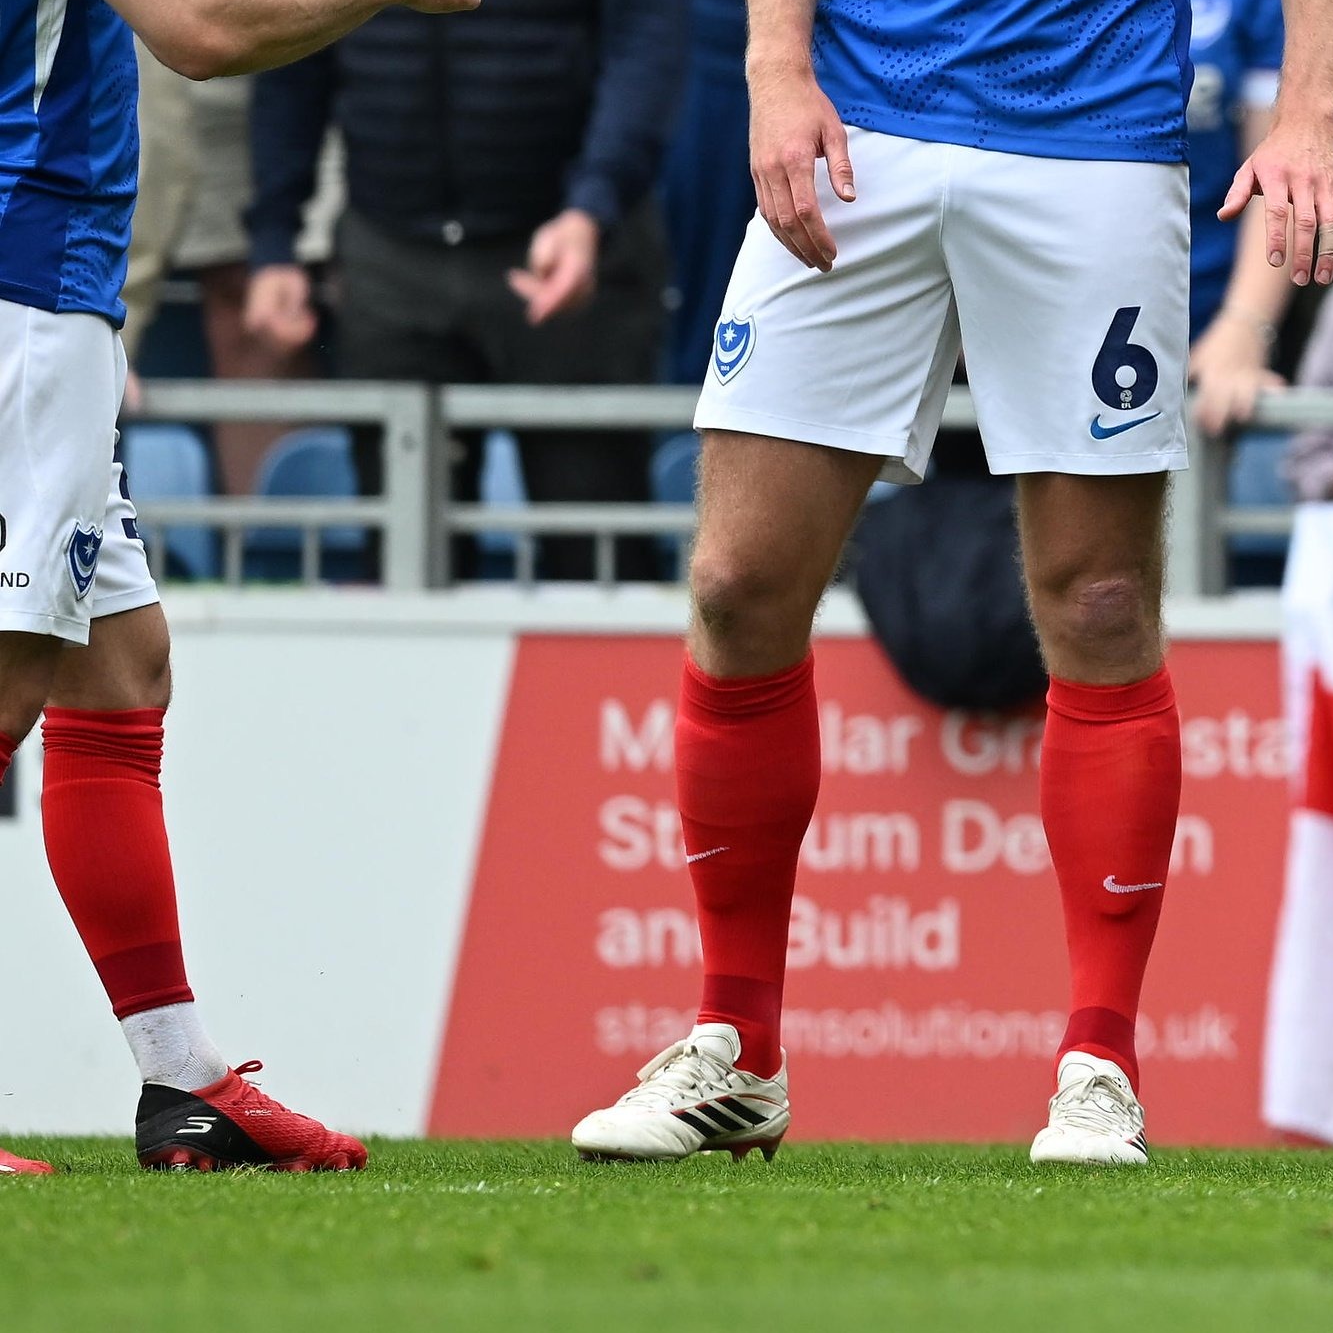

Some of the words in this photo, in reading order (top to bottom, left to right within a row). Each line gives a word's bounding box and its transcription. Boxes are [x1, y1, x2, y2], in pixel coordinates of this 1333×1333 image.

[1091, 305, 1159, 411] 6
[602, 698, 925, 775] Mlar
[598, 794, 922, 874] Stum
[943, 798, 1214, 877] Den
[596, 907, 702, 968] an
